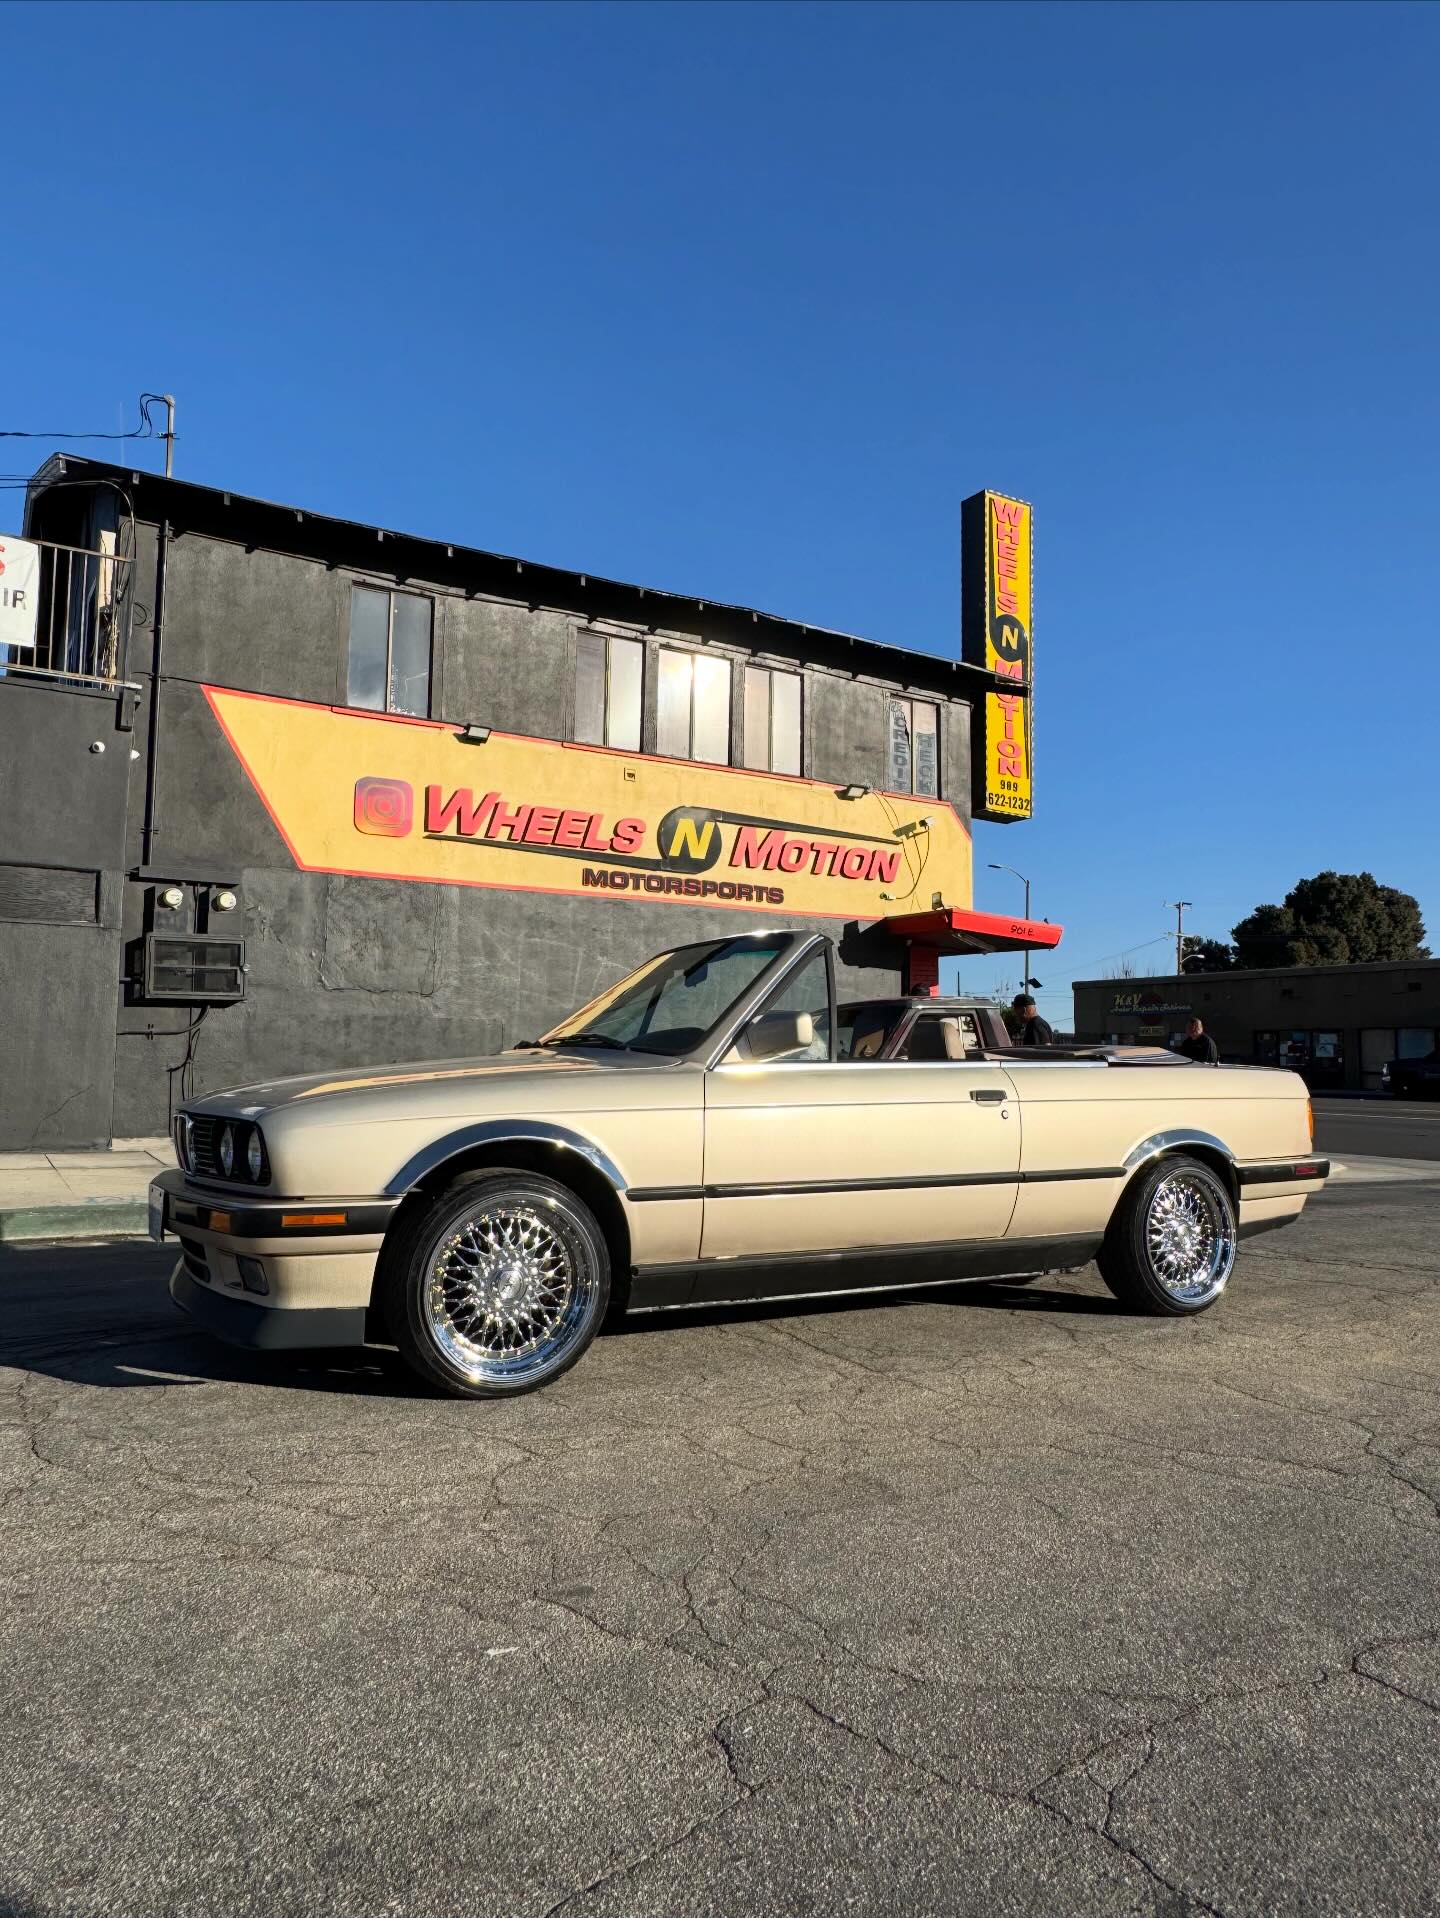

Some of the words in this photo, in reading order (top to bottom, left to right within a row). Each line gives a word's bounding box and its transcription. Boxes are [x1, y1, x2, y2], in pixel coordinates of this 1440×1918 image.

[993, 499, 1024, 615] WHEELS
[1002, 625, 1018, 649] N
[1000, 780, 1018, 792] 909
[988, 792, 1030, 811] 622-1232
[424, 784, 647, 853] WHEELS
[669, 818, 715, 860] N
[728, 826, 902, 884] MOTION
[582, 868, 785, 905] MOTORSPORTS
